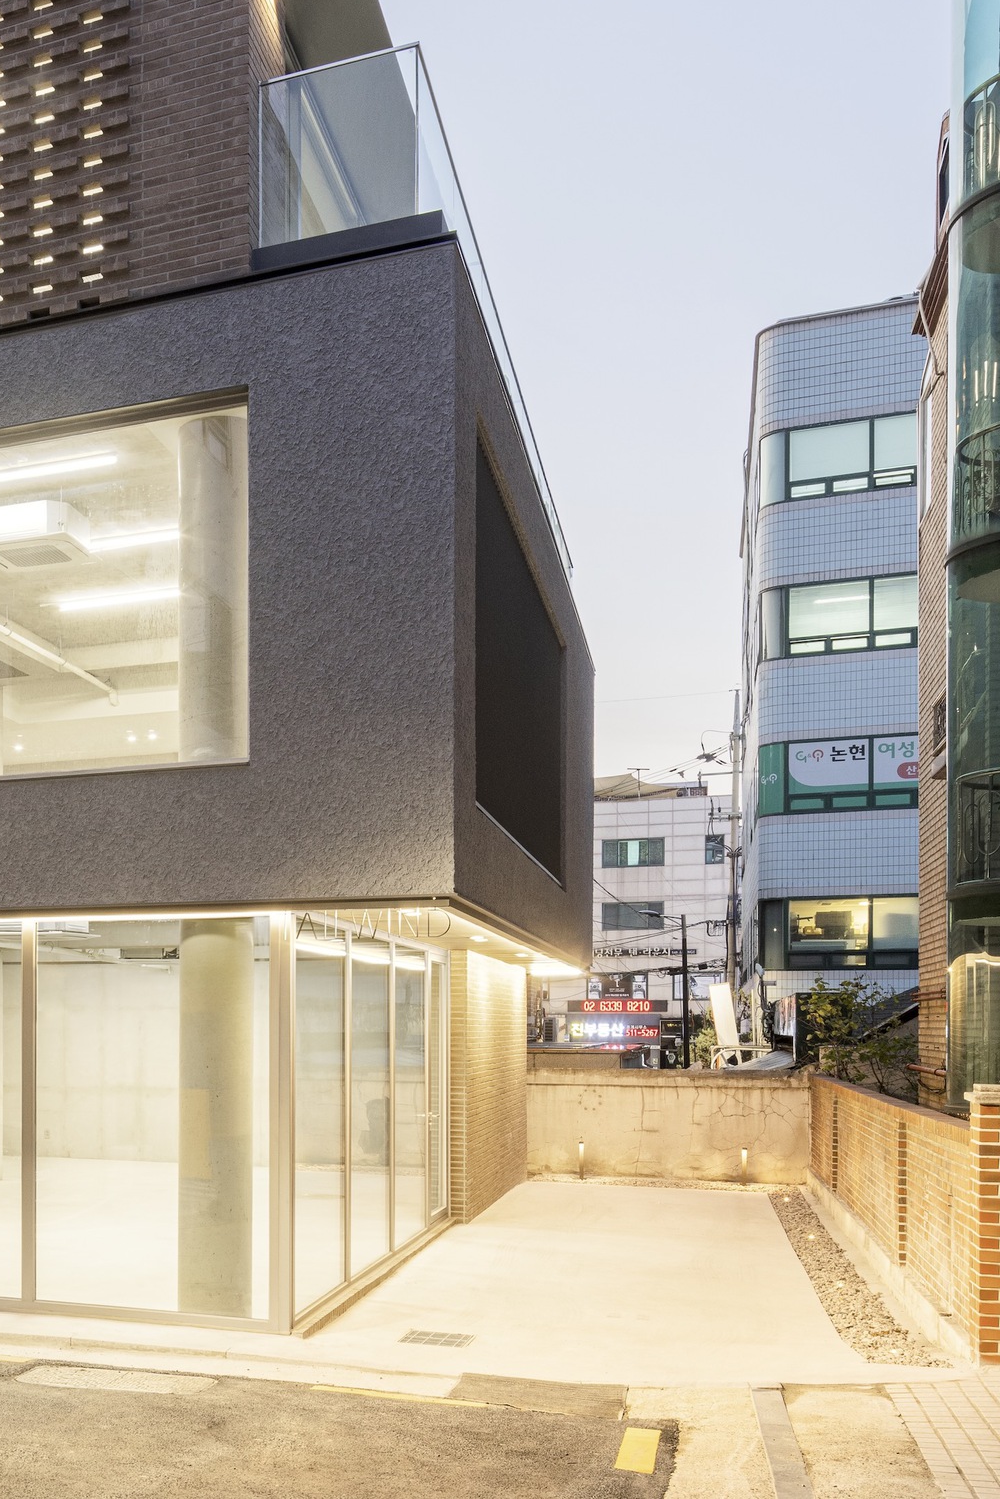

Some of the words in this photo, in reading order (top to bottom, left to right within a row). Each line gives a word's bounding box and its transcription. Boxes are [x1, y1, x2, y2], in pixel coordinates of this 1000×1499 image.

[830, 744, 866, 762] 논현
[878, 741, 919, 759] 여성
[905, 765, 919, 776] 산
[592, 947, 623, 958] 닝전문
[583, 1001, 596, 1012] 02
[600, 1001, 623, 1012] 6339
[627, 1001, 650, 1012] 8210
[626, 1029, 658, 1037] 511-5267
